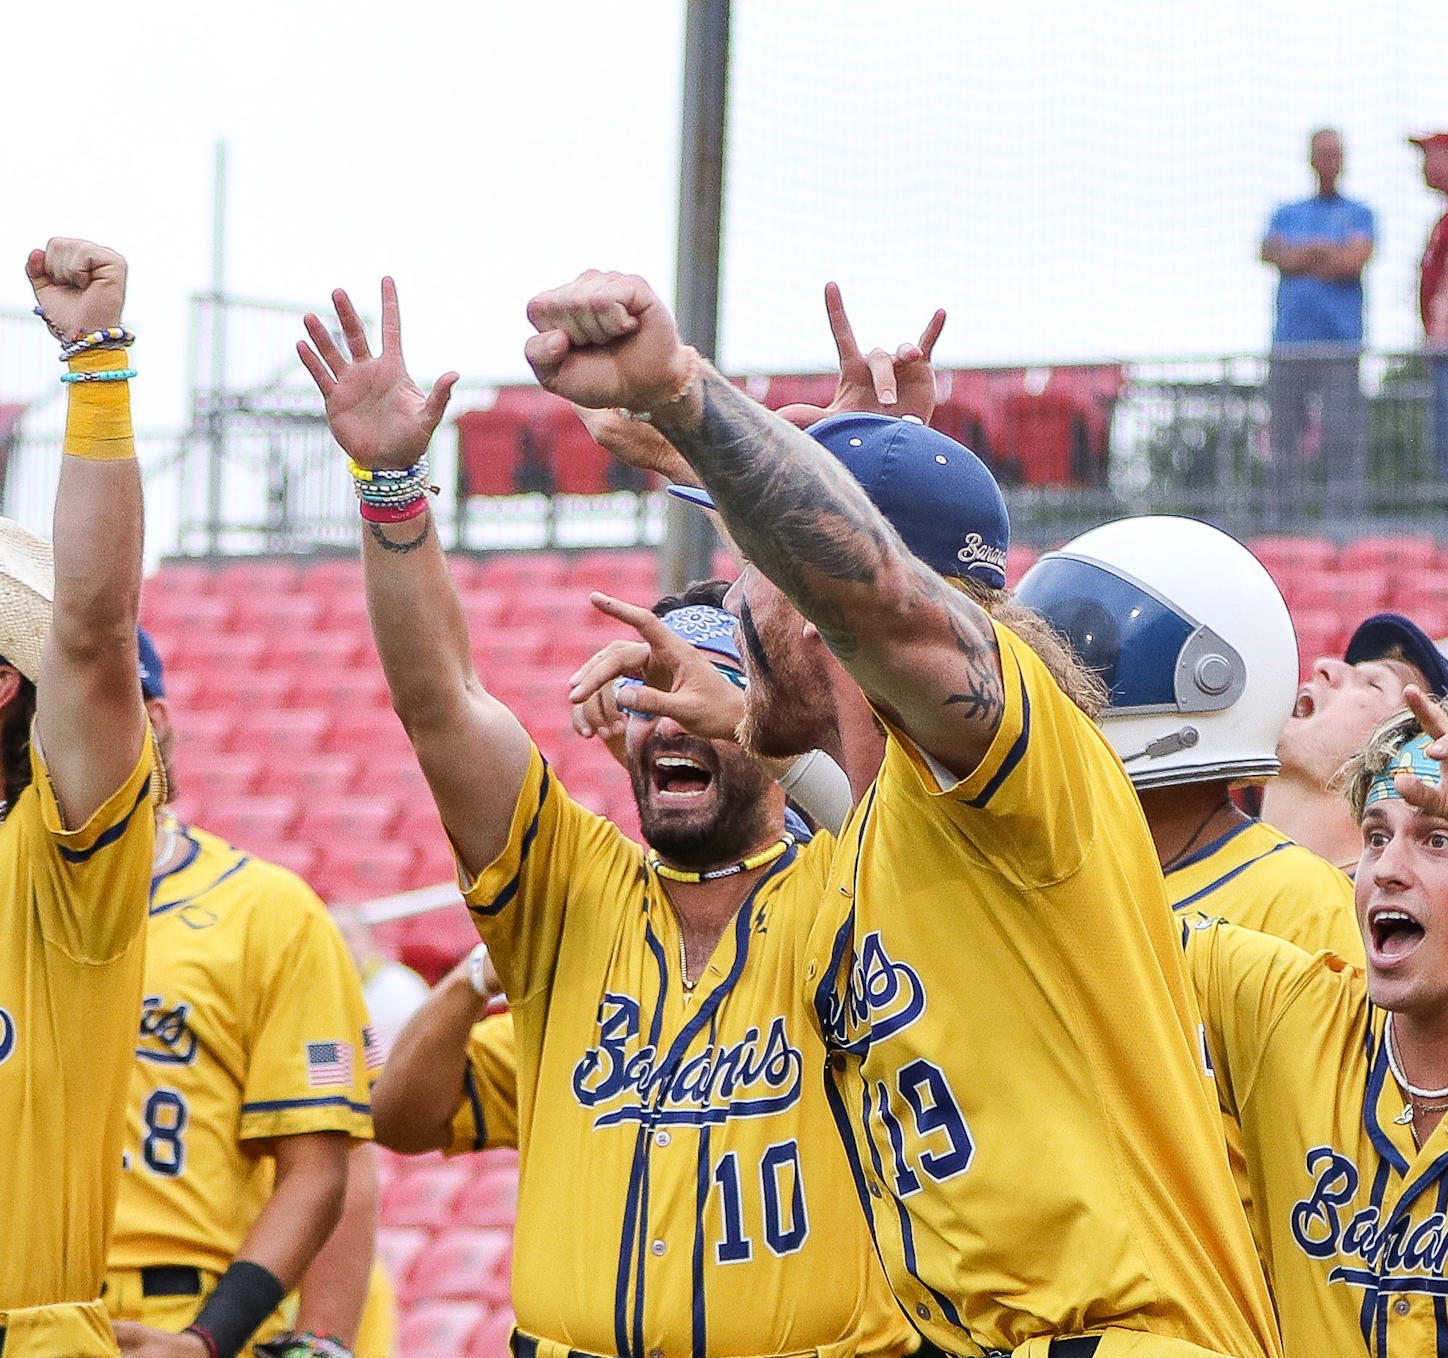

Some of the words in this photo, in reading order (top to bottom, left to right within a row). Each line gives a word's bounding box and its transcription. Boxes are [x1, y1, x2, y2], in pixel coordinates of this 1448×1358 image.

[122, 1086, 189, 1180] 8
[875, 1057, 976, 1200] 19
[713, 1137, 811, 1266] 10
